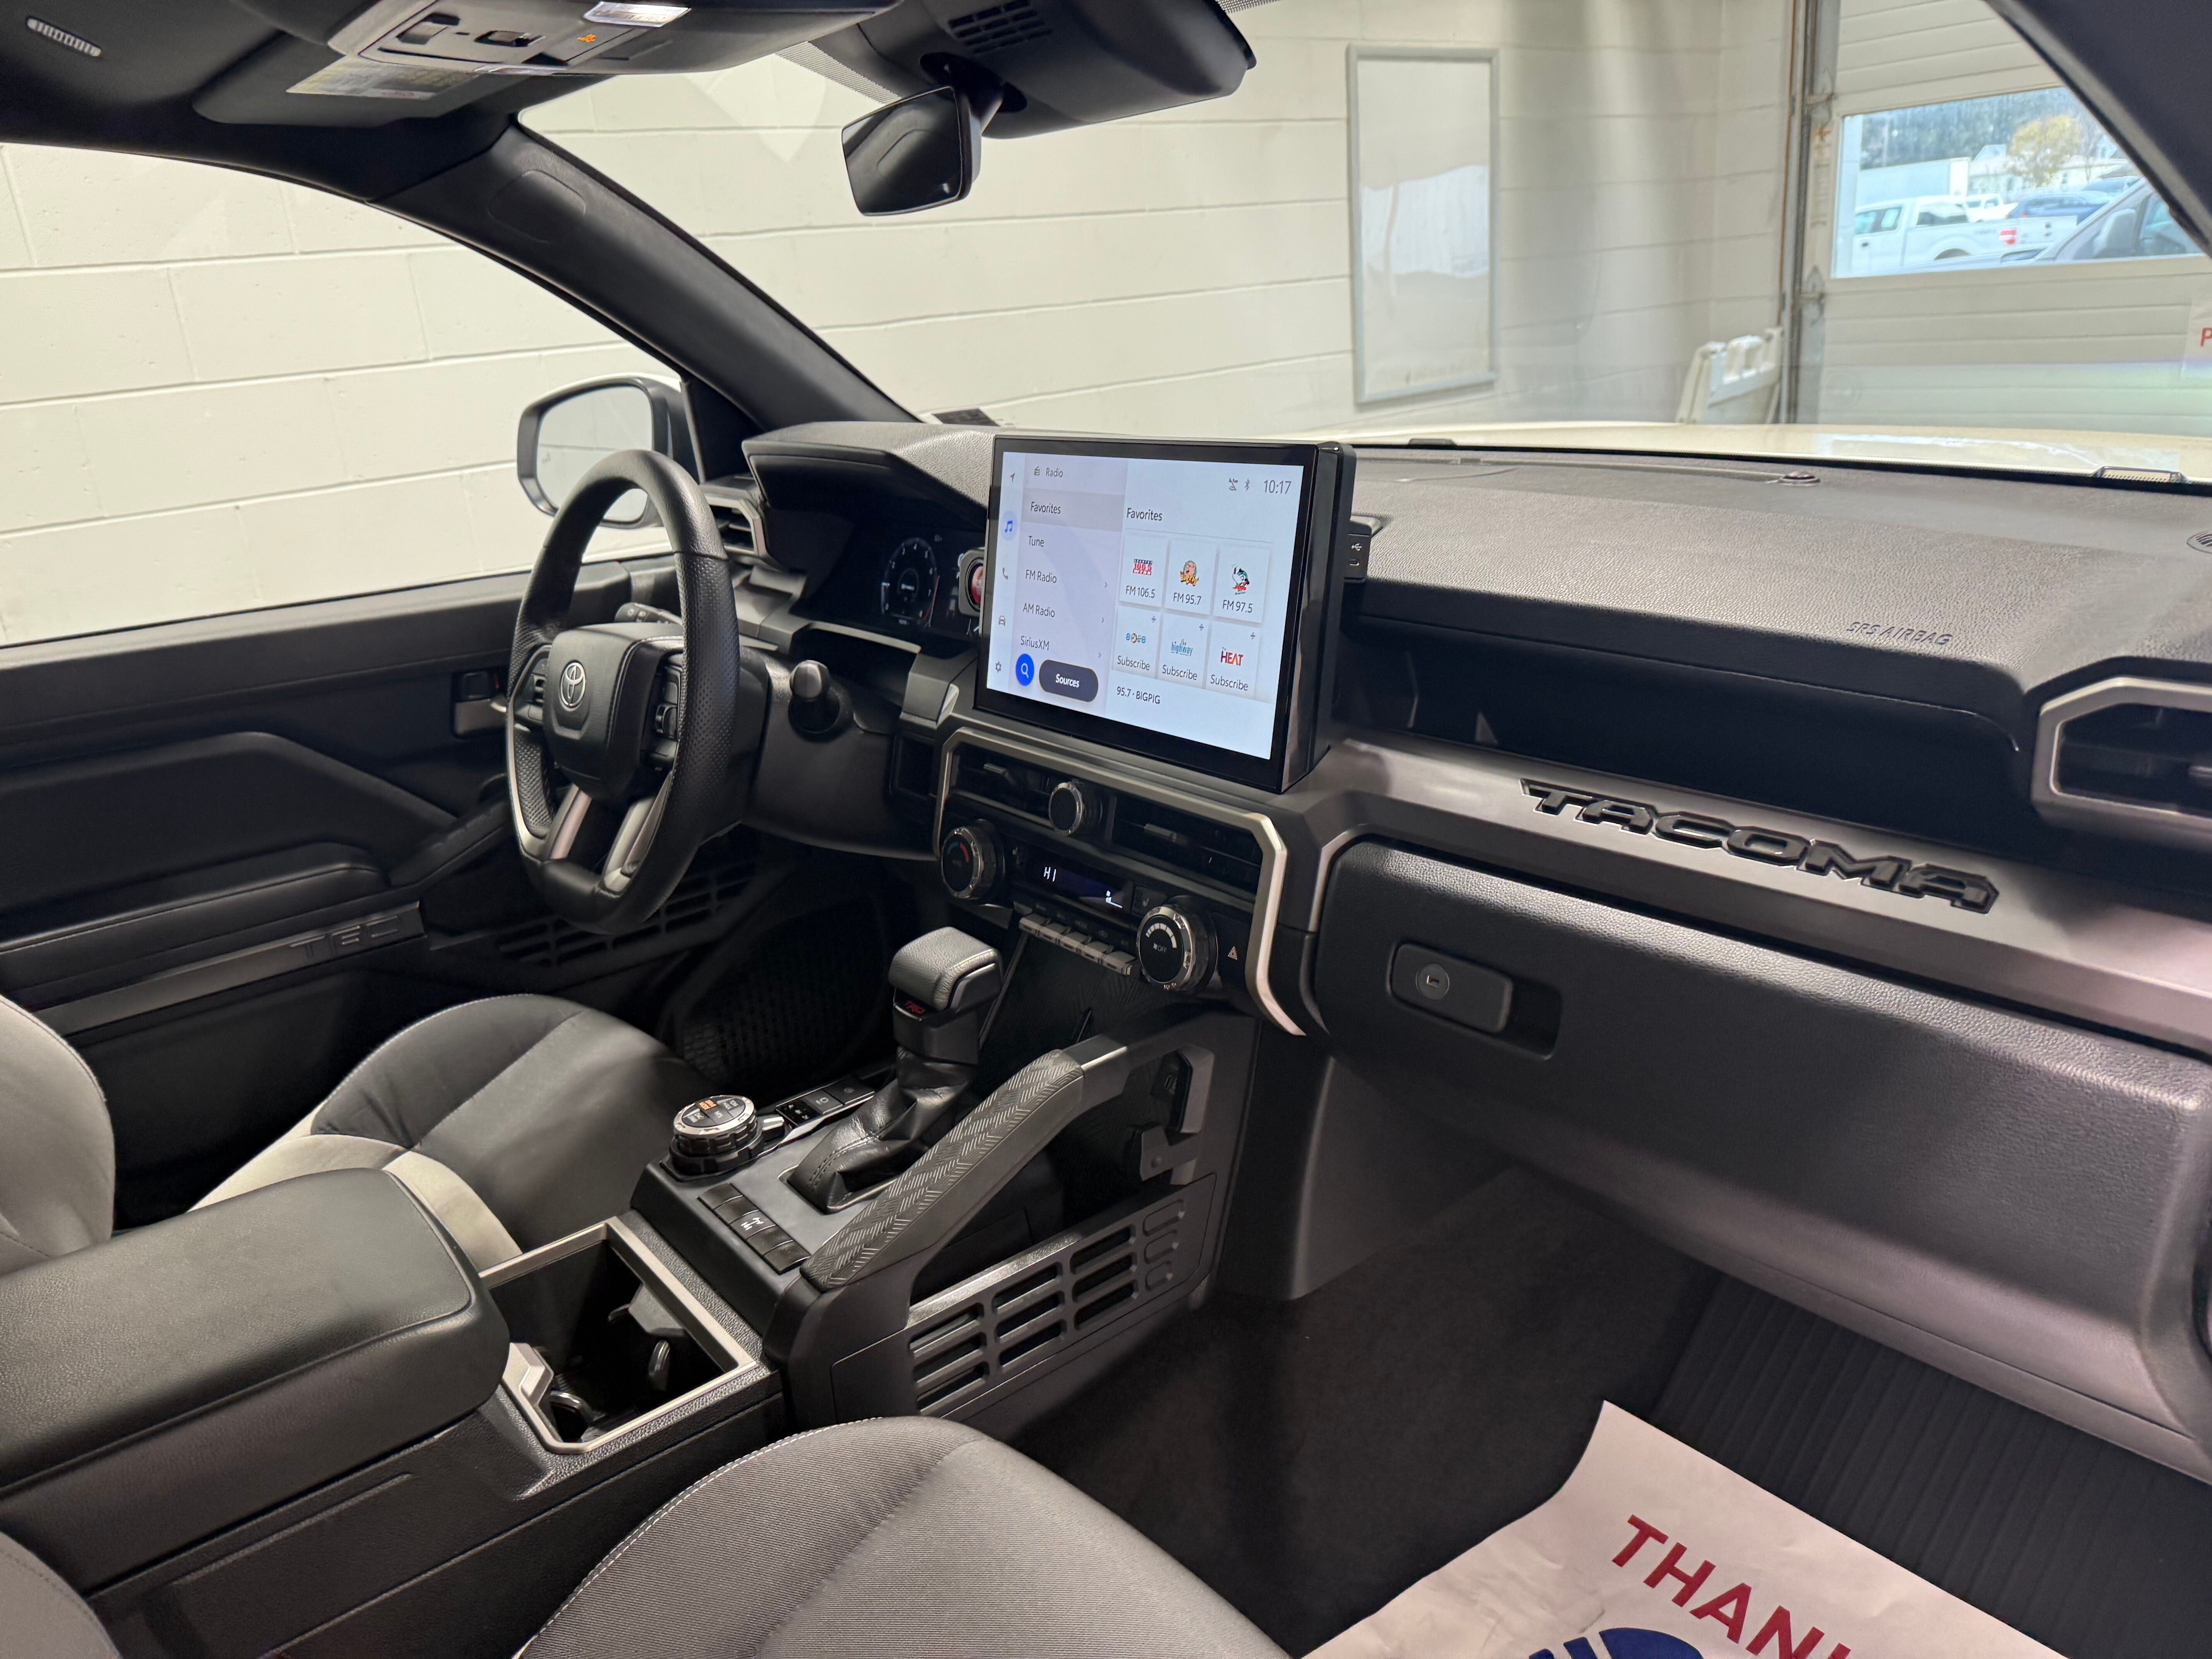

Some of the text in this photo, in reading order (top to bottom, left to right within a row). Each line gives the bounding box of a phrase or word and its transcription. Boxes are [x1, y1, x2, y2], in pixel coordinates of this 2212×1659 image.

[1046, 467, 1063, 477] Radio
[1264, 480, 1291, 494] 10:17
[1030, 501, 1061, 514] Favorites
[1127, 507, 1163, 521] Favorites
[1028, 536, 1044, 547] Tune
[1025, 569, 1057, 584] FM Radio
[1125, 585, 1156, 599] FM 106.5
[1173, 592, 1202, 605] FM 95.7
[1023, 603, 1055, 617] AM Radio
[1222, 599, 1253, 613] FM 97.5
[1020, 635, 1049, 651] SiriusXM
[1879, 626, 1953, 645] AIRBAG
[1171, 641, 1193, 656] highway
[1117, 655, 1150, 671] Subscribe
[1220, 650, 1244, 666] HEAT
[1162, 665, 1197, 680] Subscribe
[1055, 673, 1080, 688] Sources
[1210, 674, 1249, 691] Subscribe
[1117, 686, 1161, 704] 95.7 BIGPIG
[1518, 778, 2000, 914] TACOMA
[1044, 866, 1056, 882] HI
[1612, 1514, 1851, 1659] THAN
